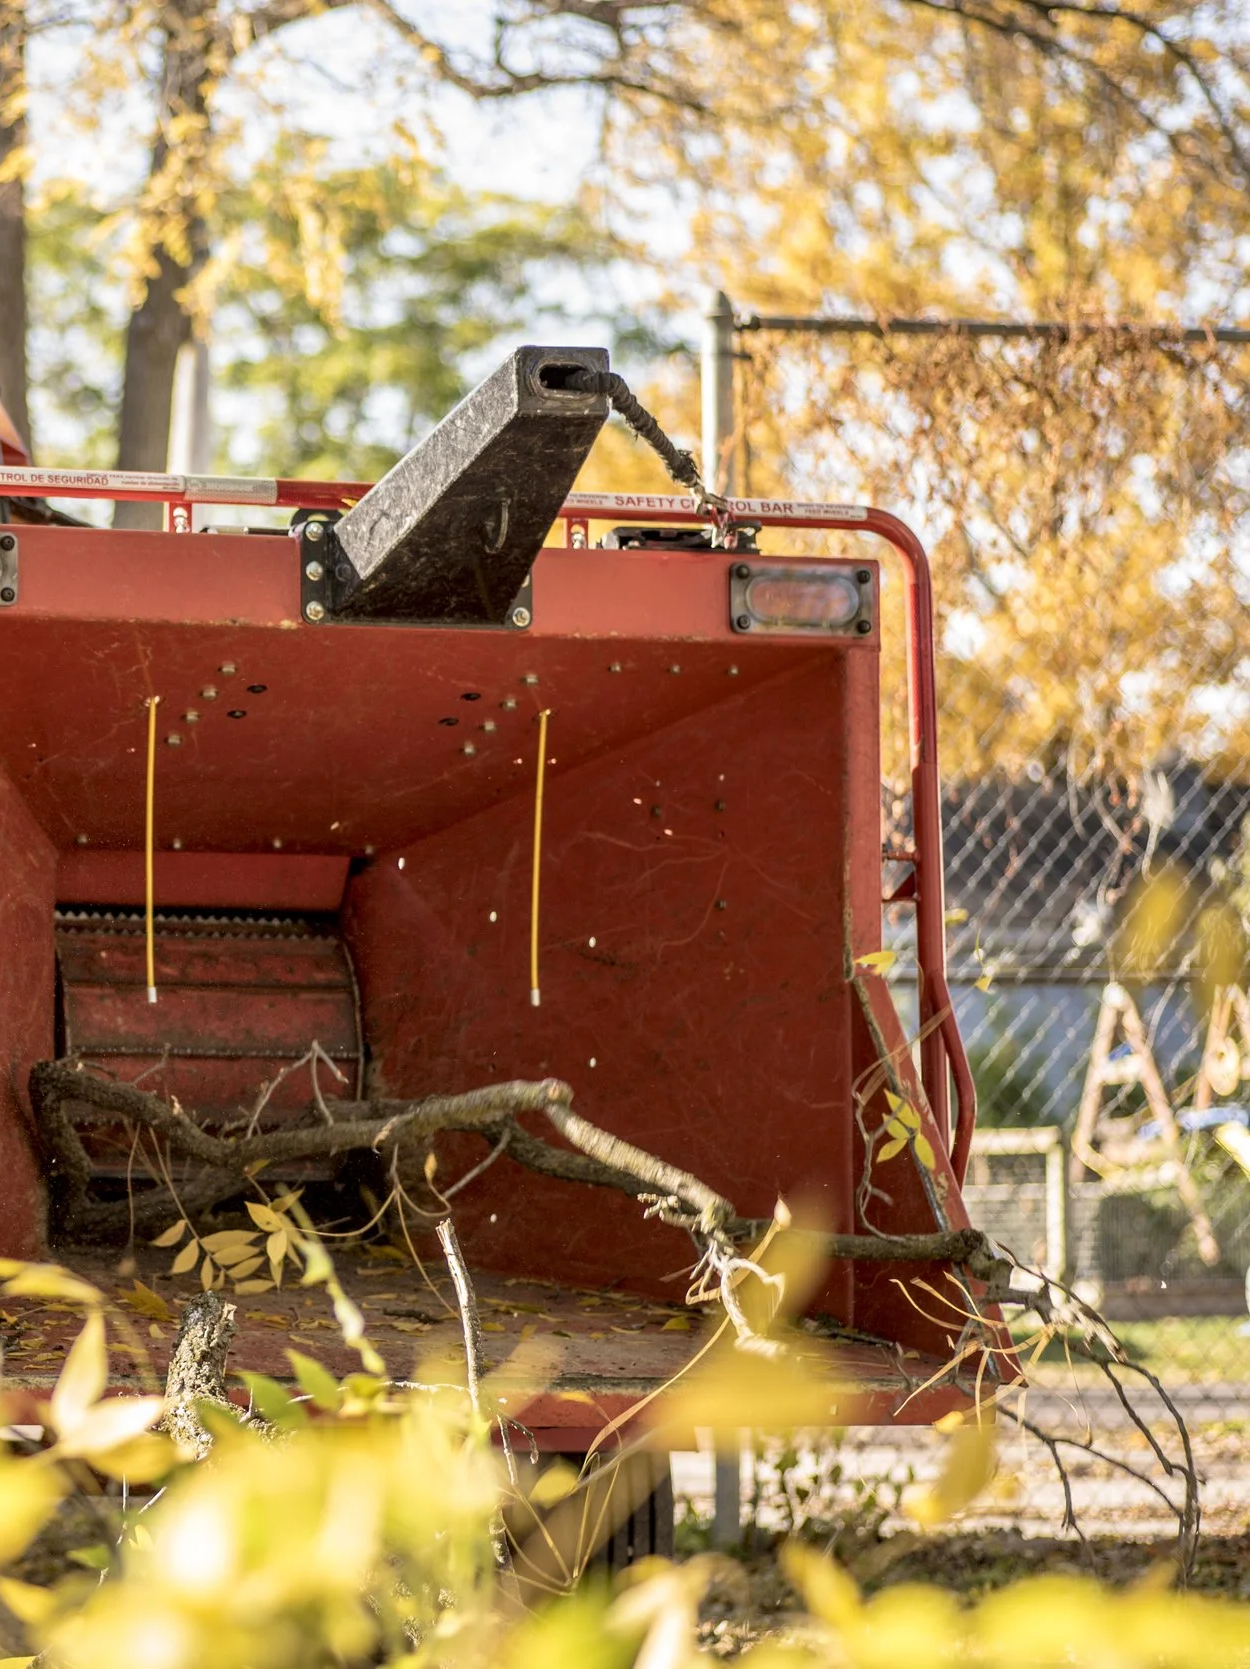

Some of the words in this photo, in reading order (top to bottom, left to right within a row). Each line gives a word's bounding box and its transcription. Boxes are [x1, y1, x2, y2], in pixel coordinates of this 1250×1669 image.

[30, 474, 44, 483] DE
[47, 475, 109, 486] SEGURIDAD
[615, 496, 675, 508] SAFETY
[760, 502, 794, 514] BAR
